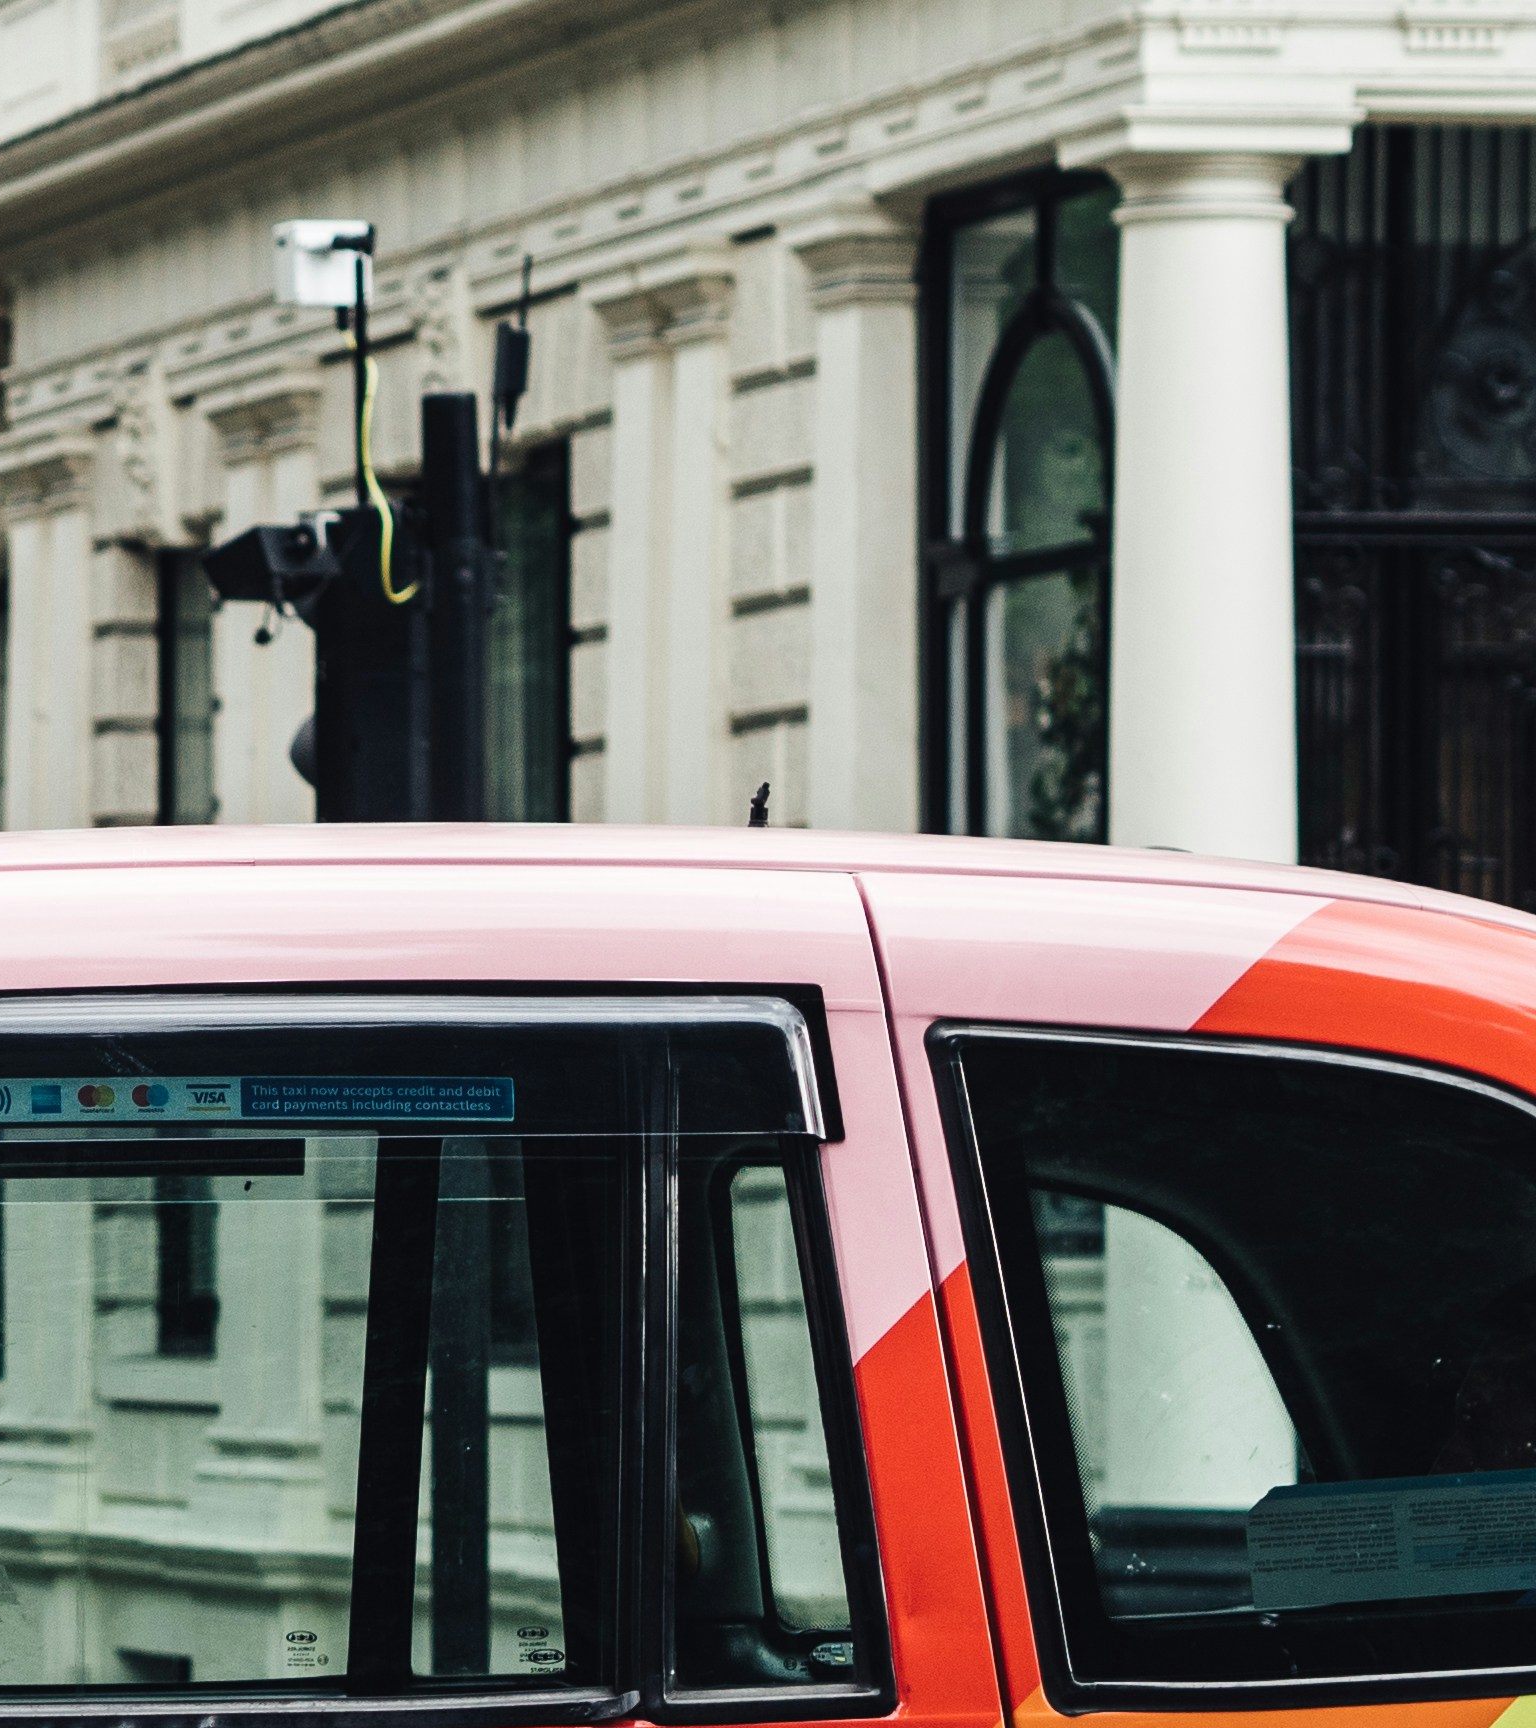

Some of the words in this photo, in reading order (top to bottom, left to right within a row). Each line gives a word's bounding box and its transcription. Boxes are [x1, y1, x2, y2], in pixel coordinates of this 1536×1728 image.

[191, 1091, 227, 1104] VISA
[251, 1085, 278, 1096] This
[282, 1085, 307, 1096] taxi
[311, 1087, 339, 1096] now
[342, 1086, 393, 1098] accepts
[397, 1085, 435, 1097] credit
[439, 1086, 463, 1097] and
[467, 1086, 502, 1097] debit
[251, 1099, 280, 1110] card
[284, 1100, 348, 1112] payments
[352, 1100, 412, 1112] including
[415, 1100, 491, 1111] contactless
